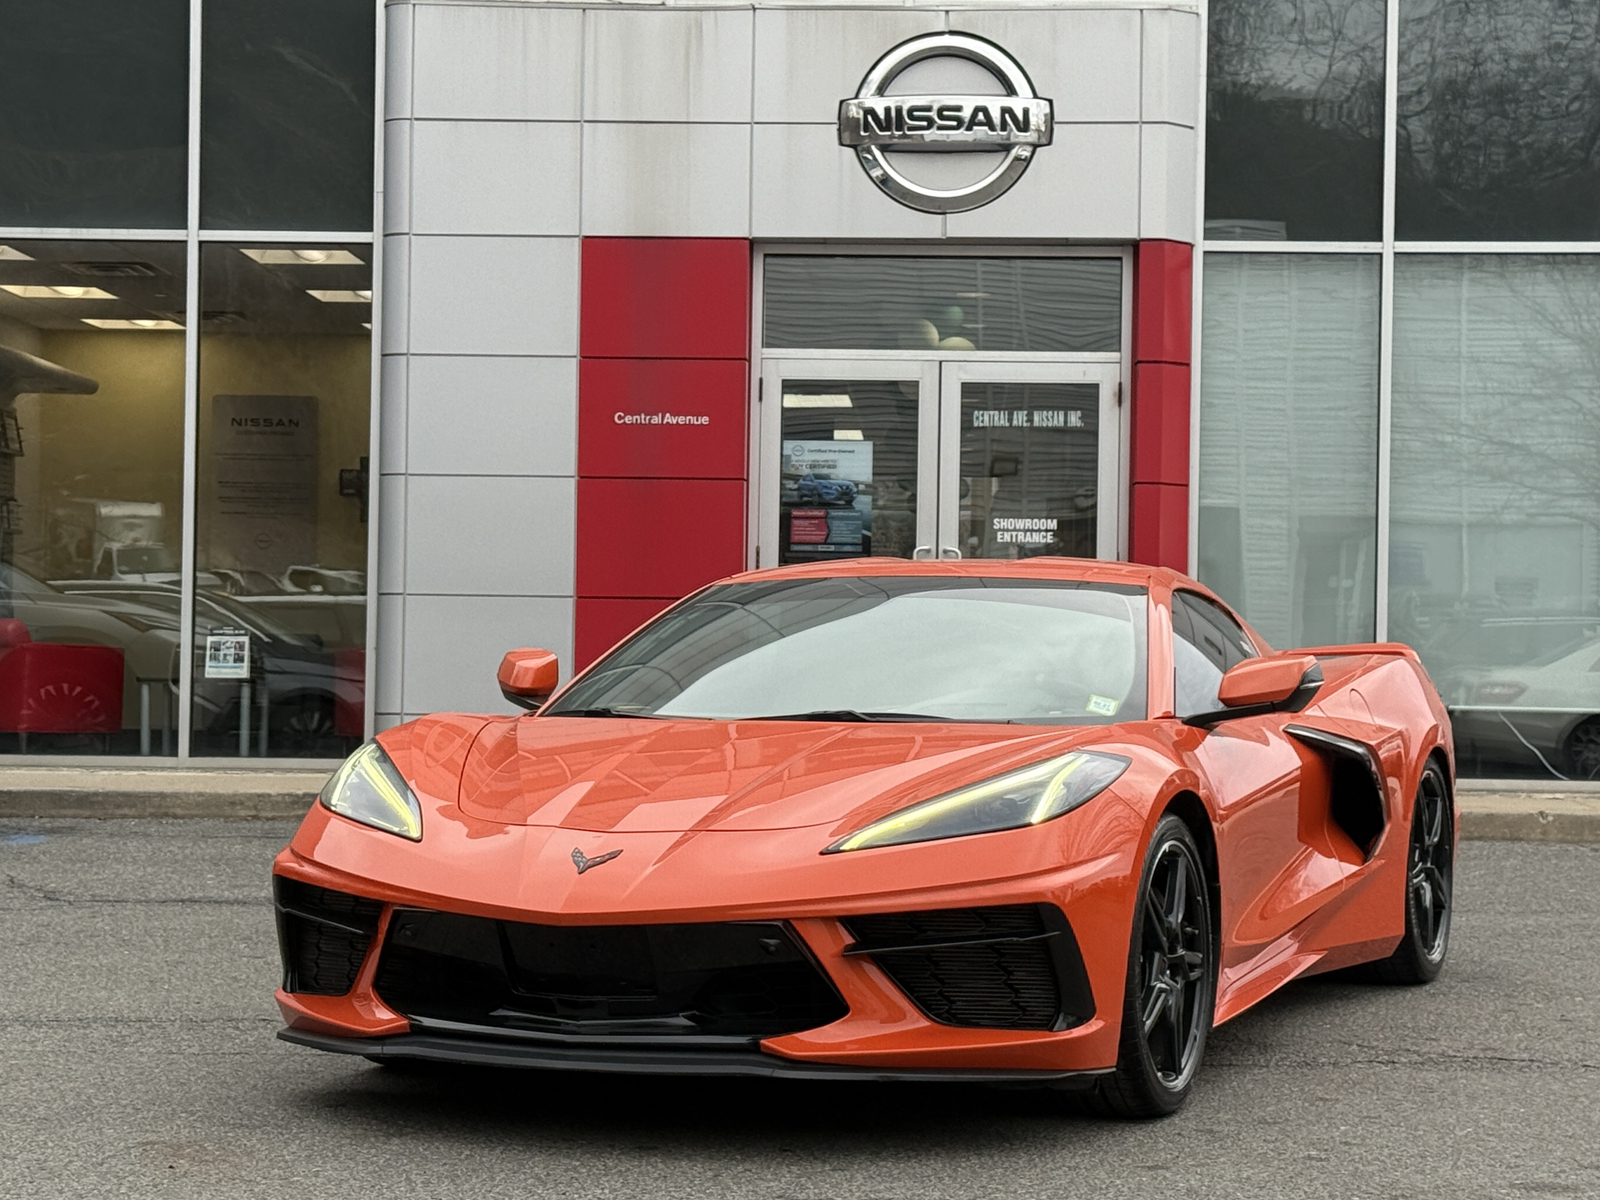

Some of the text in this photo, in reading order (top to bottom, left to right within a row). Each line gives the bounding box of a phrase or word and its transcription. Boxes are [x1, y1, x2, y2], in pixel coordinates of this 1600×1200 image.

[861, 104, 1031, 135] NISSAN
[231, 417, 300, 428] NISSAN
[614, 411, 710, 425] Central Avenue
[973, 410, 1085, 428] CENTRAL AVE. NISSAN INC.
[993, 518, 1058, 530] SHOWROOM
[997, 531, 1054, 543] ENTRANCE
